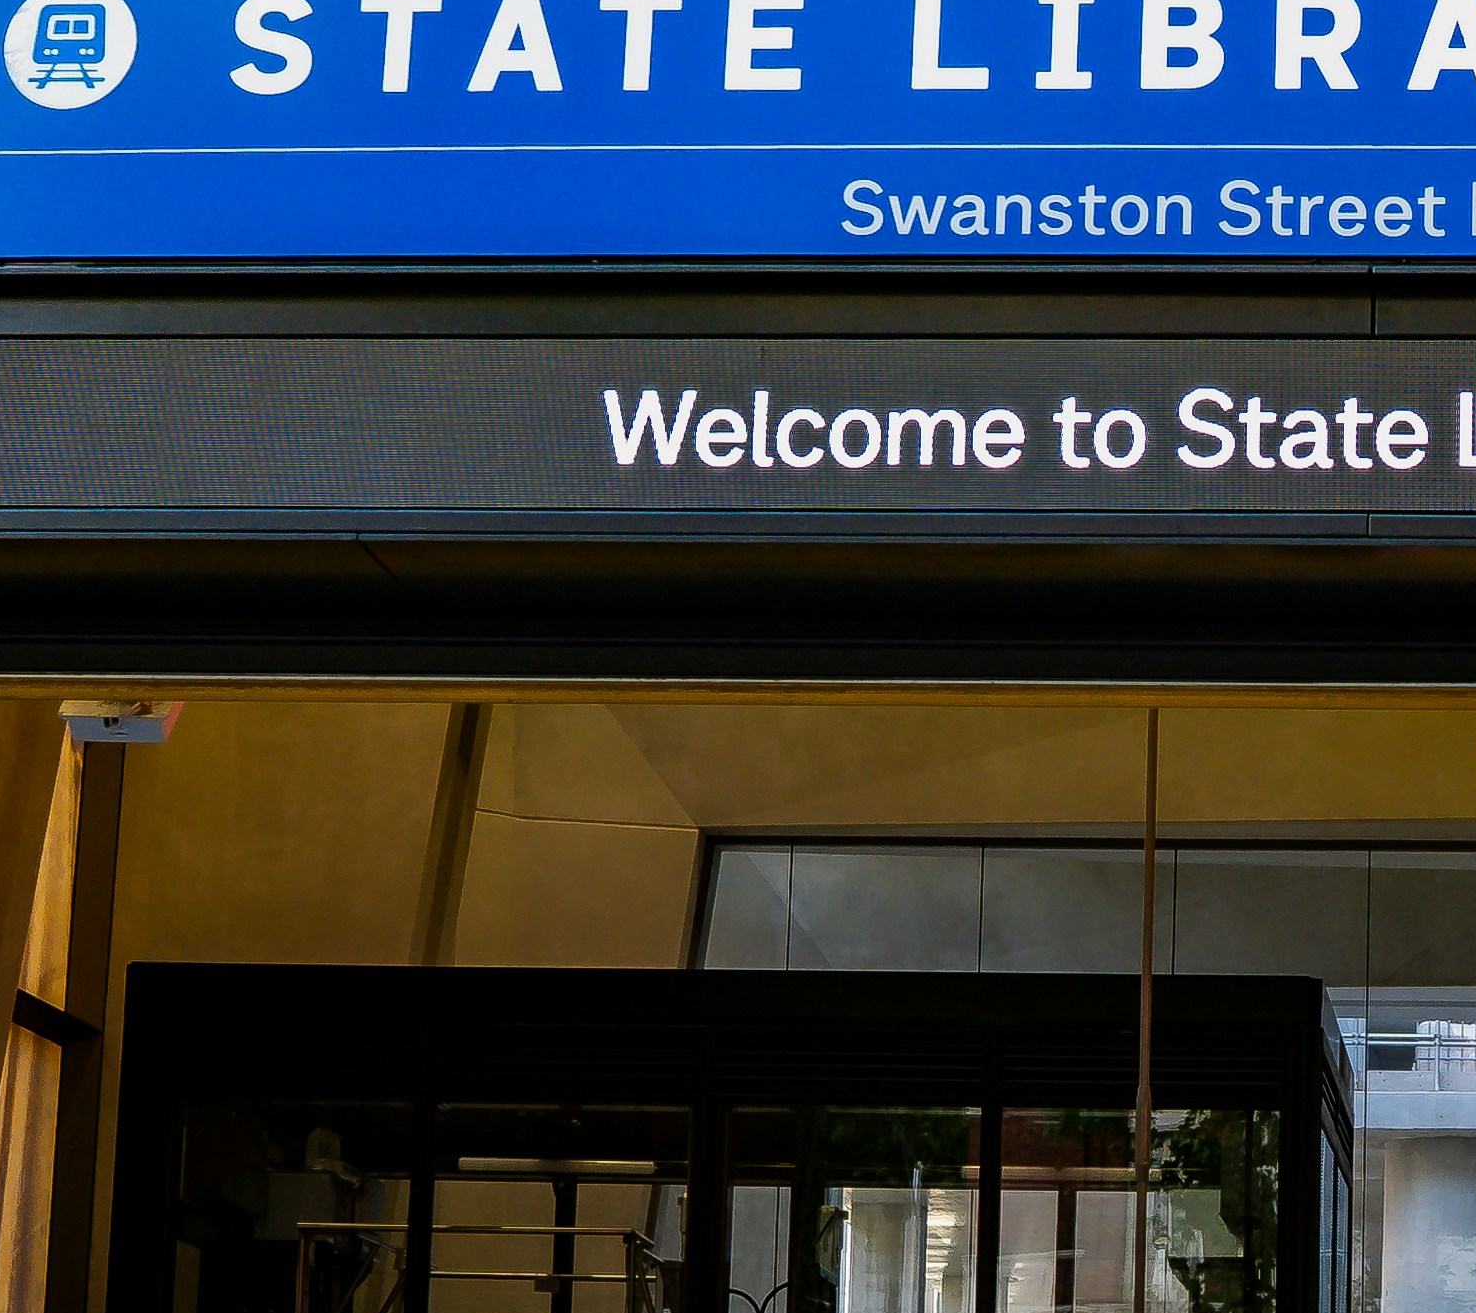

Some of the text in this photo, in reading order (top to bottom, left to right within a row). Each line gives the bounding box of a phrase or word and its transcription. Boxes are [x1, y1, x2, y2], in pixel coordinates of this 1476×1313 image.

[841, 178, 1193, 237] Swanston
[1218, 178, 1446, 238] Street
[602, 388, 1027, 470] Welcome
[1052, 395, 1148, 470] to
[1177, 386, 1429, 470] State
